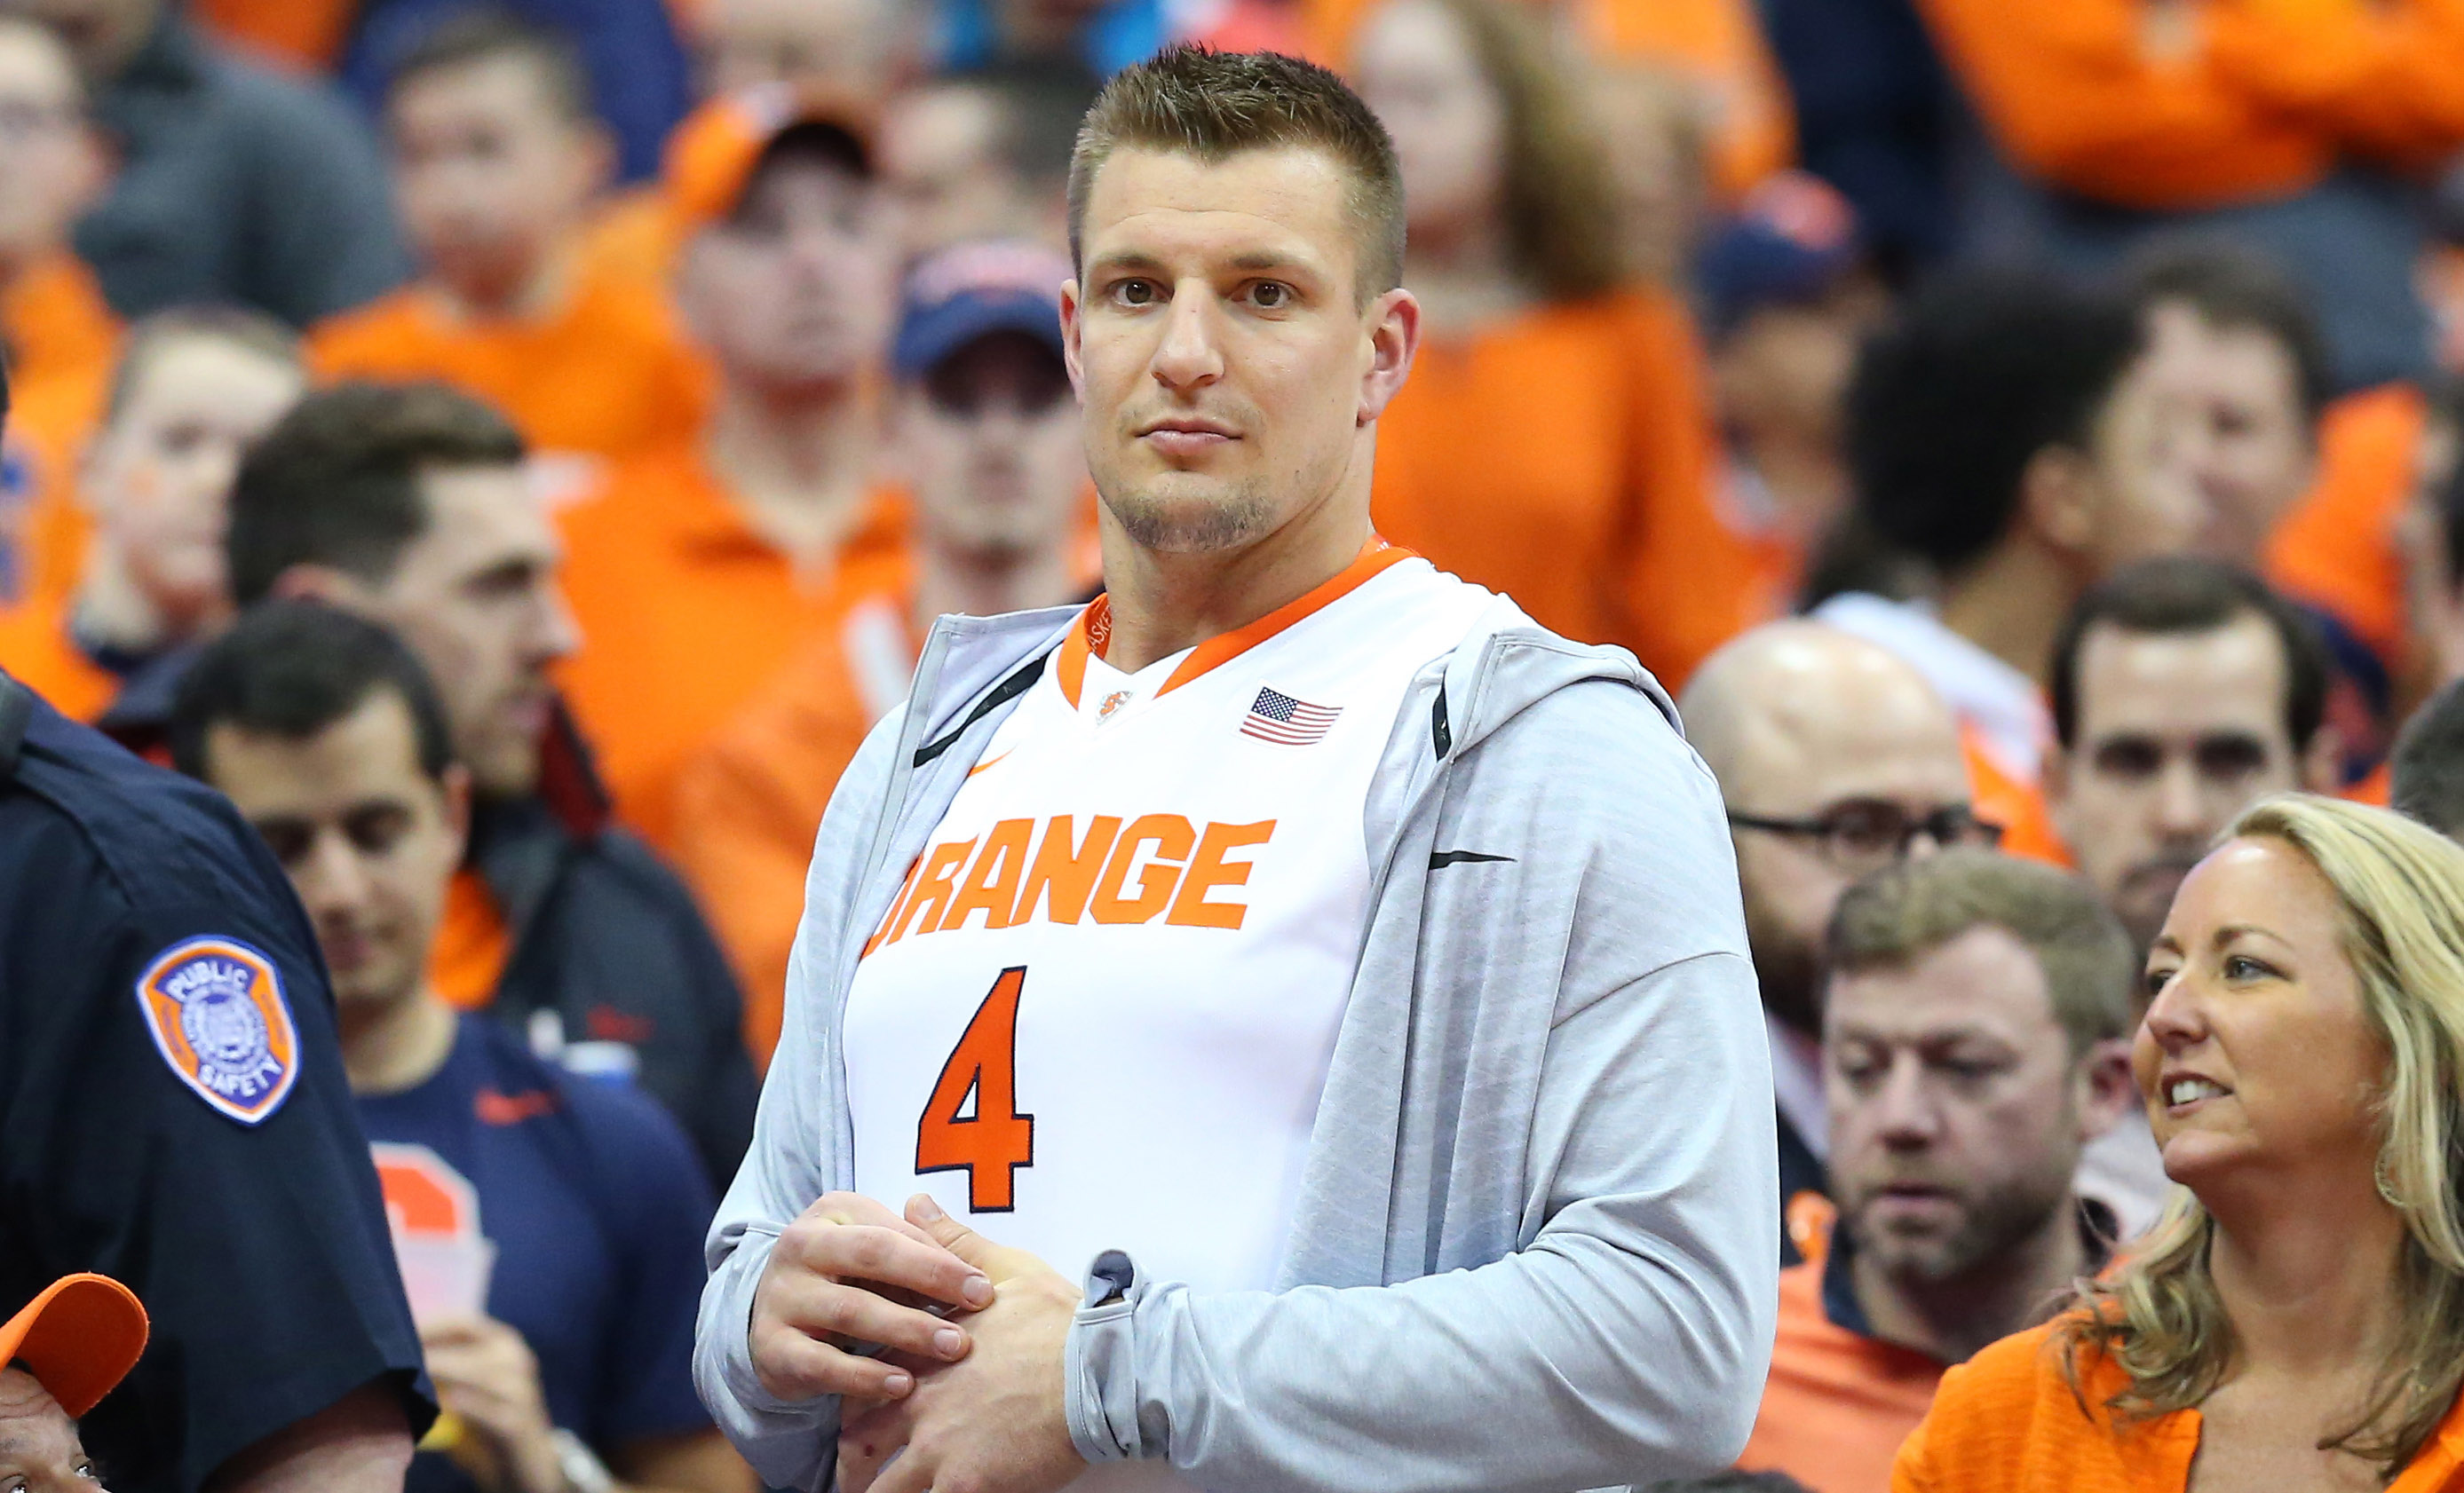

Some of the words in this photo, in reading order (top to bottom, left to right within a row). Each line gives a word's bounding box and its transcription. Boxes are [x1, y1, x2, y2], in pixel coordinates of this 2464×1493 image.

[166, 960, 250, 1003] PUBLIC
[198, 1054, 284, 1098] SAFETY
[915, 965, 1034, 1214] 4
